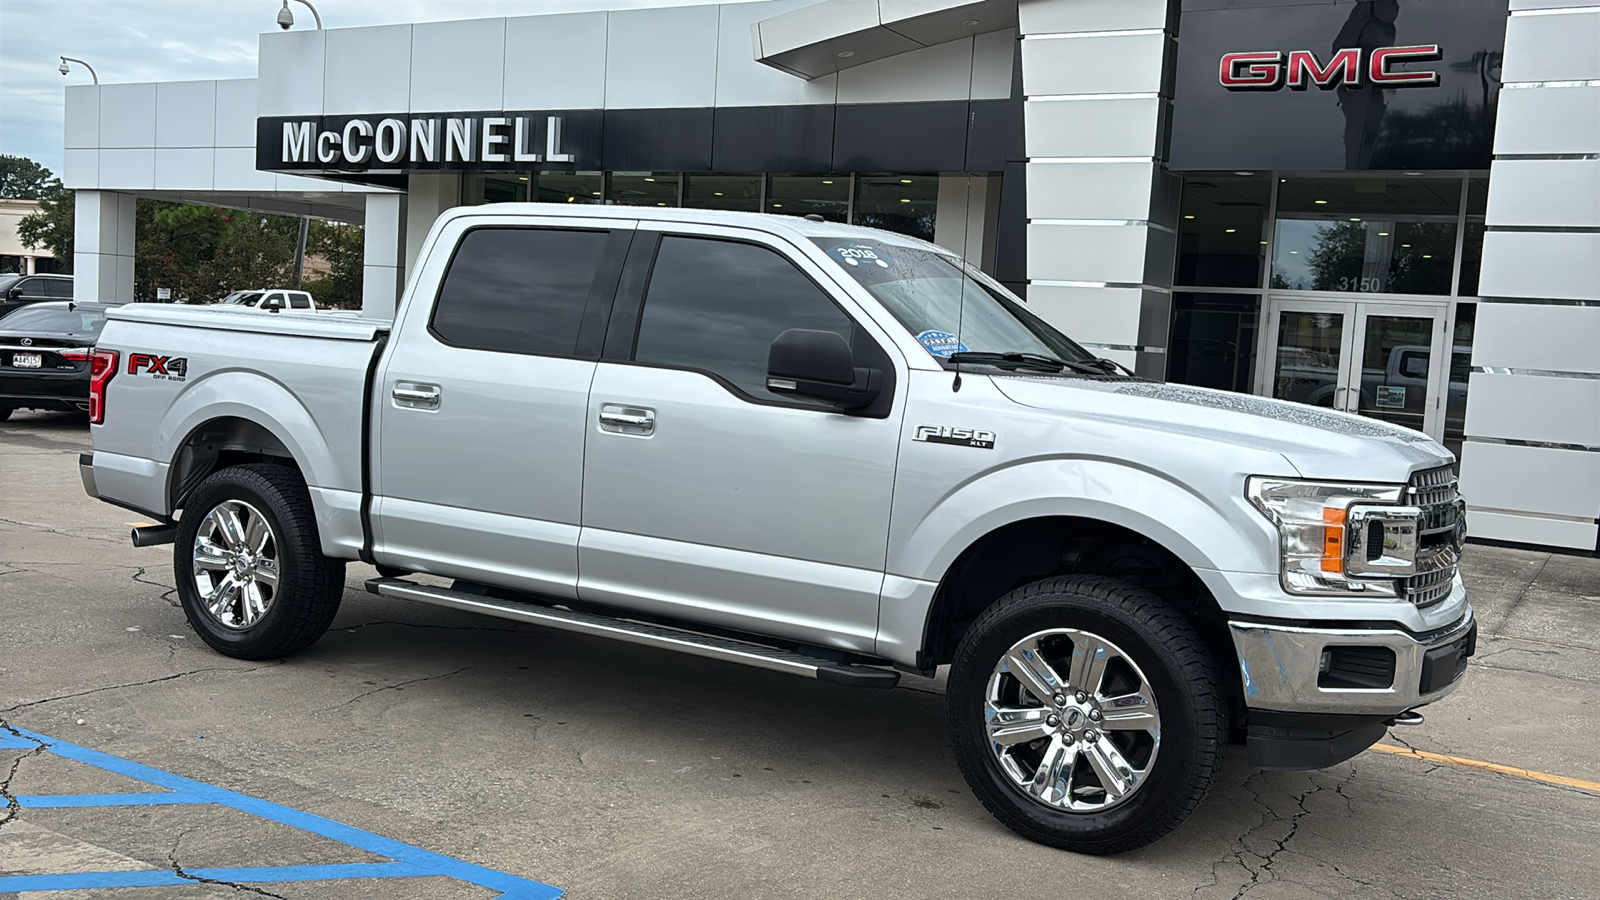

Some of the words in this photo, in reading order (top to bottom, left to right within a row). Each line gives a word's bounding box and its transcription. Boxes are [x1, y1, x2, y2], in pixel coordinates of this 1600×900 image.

[1219, 44, 1440, 88] GMC
[837, 247, 878, 259] 2018
[1339, 276, 1380, 292] 3150
[128, 353, 188, 377] FX4
